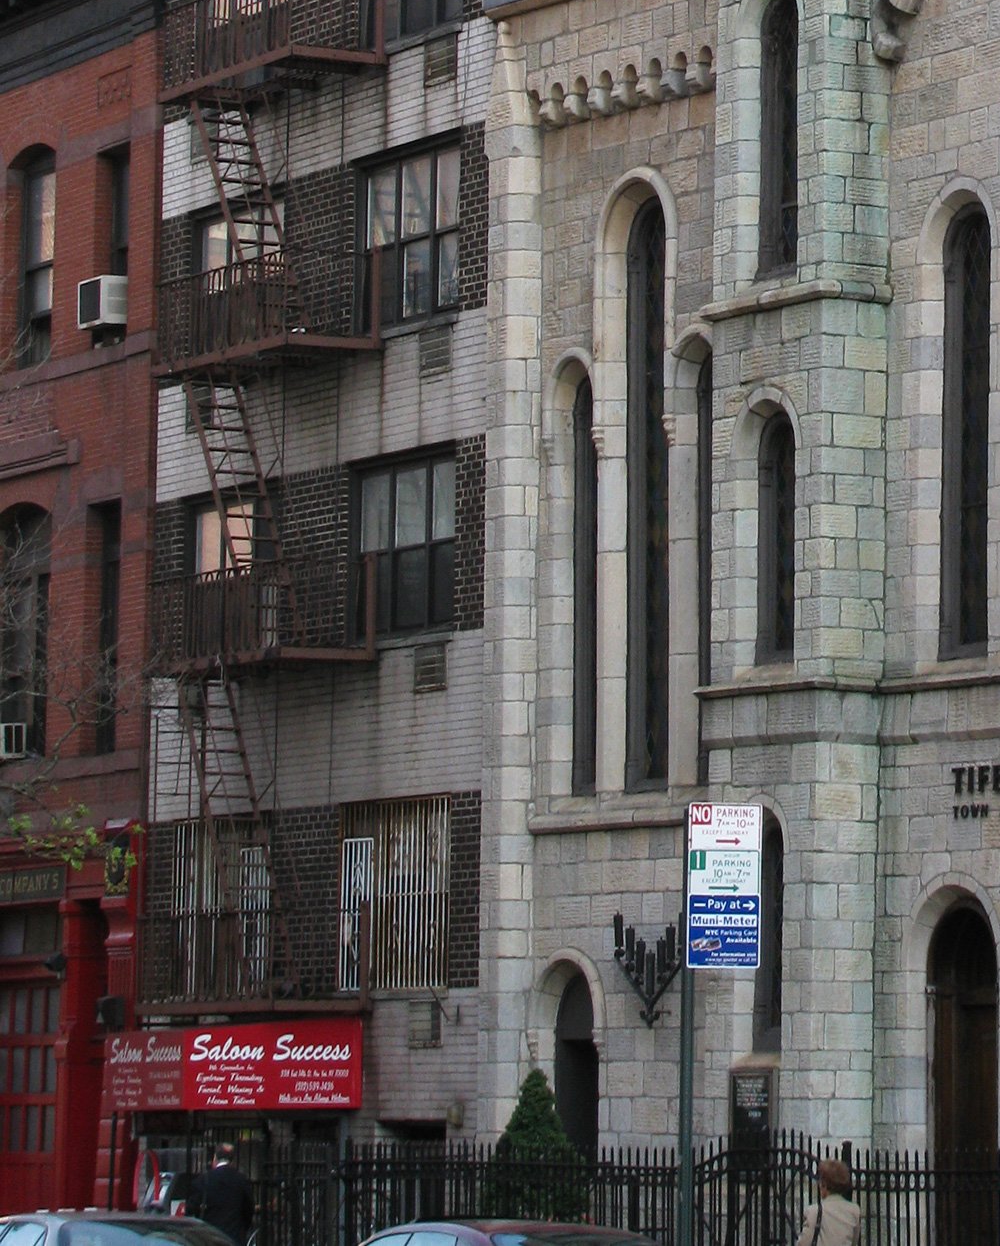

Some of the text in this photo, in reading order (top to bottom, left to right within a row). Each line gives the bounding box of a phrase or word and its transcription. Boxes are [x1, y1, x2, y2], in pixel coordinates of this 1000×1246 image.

[692, 805, 755, 823] NO PARKING
[953, 803, 989, 819] TOWN
[712, 859, 751, 867] PARKING
[707, 899, 741, 911] Pay at
[692, 915, 756, 925] Muni-Meter
[190, 1033, 352, 1061] Saloon Success
[227, 1084, 254, 1095] Waxing
